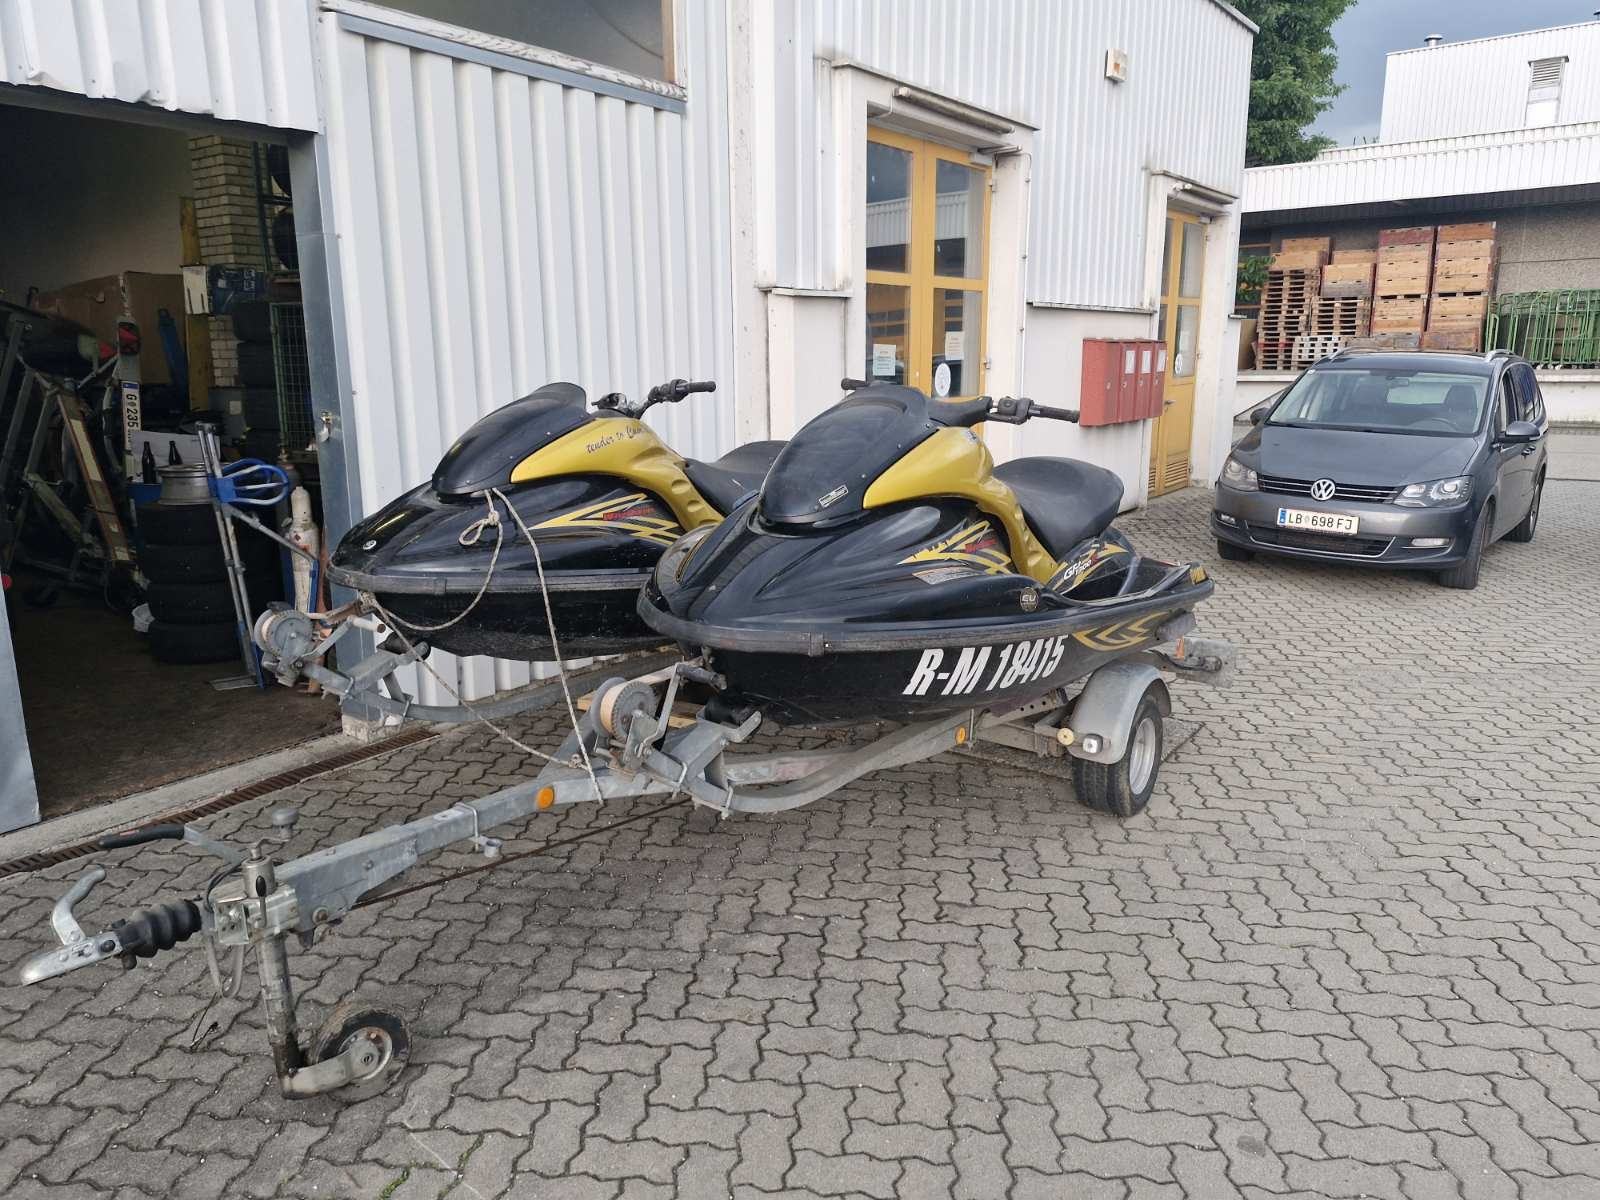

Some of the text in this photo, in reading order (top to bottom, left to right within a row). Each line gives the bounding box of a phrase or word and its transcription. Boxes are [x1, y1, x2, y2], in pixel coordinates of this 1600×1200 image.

[127, 408, 139, 428] 235
[1288, 513, 1353, 530] LB 698 FJ
[902, 634, 1069, 695] R-M 18415
